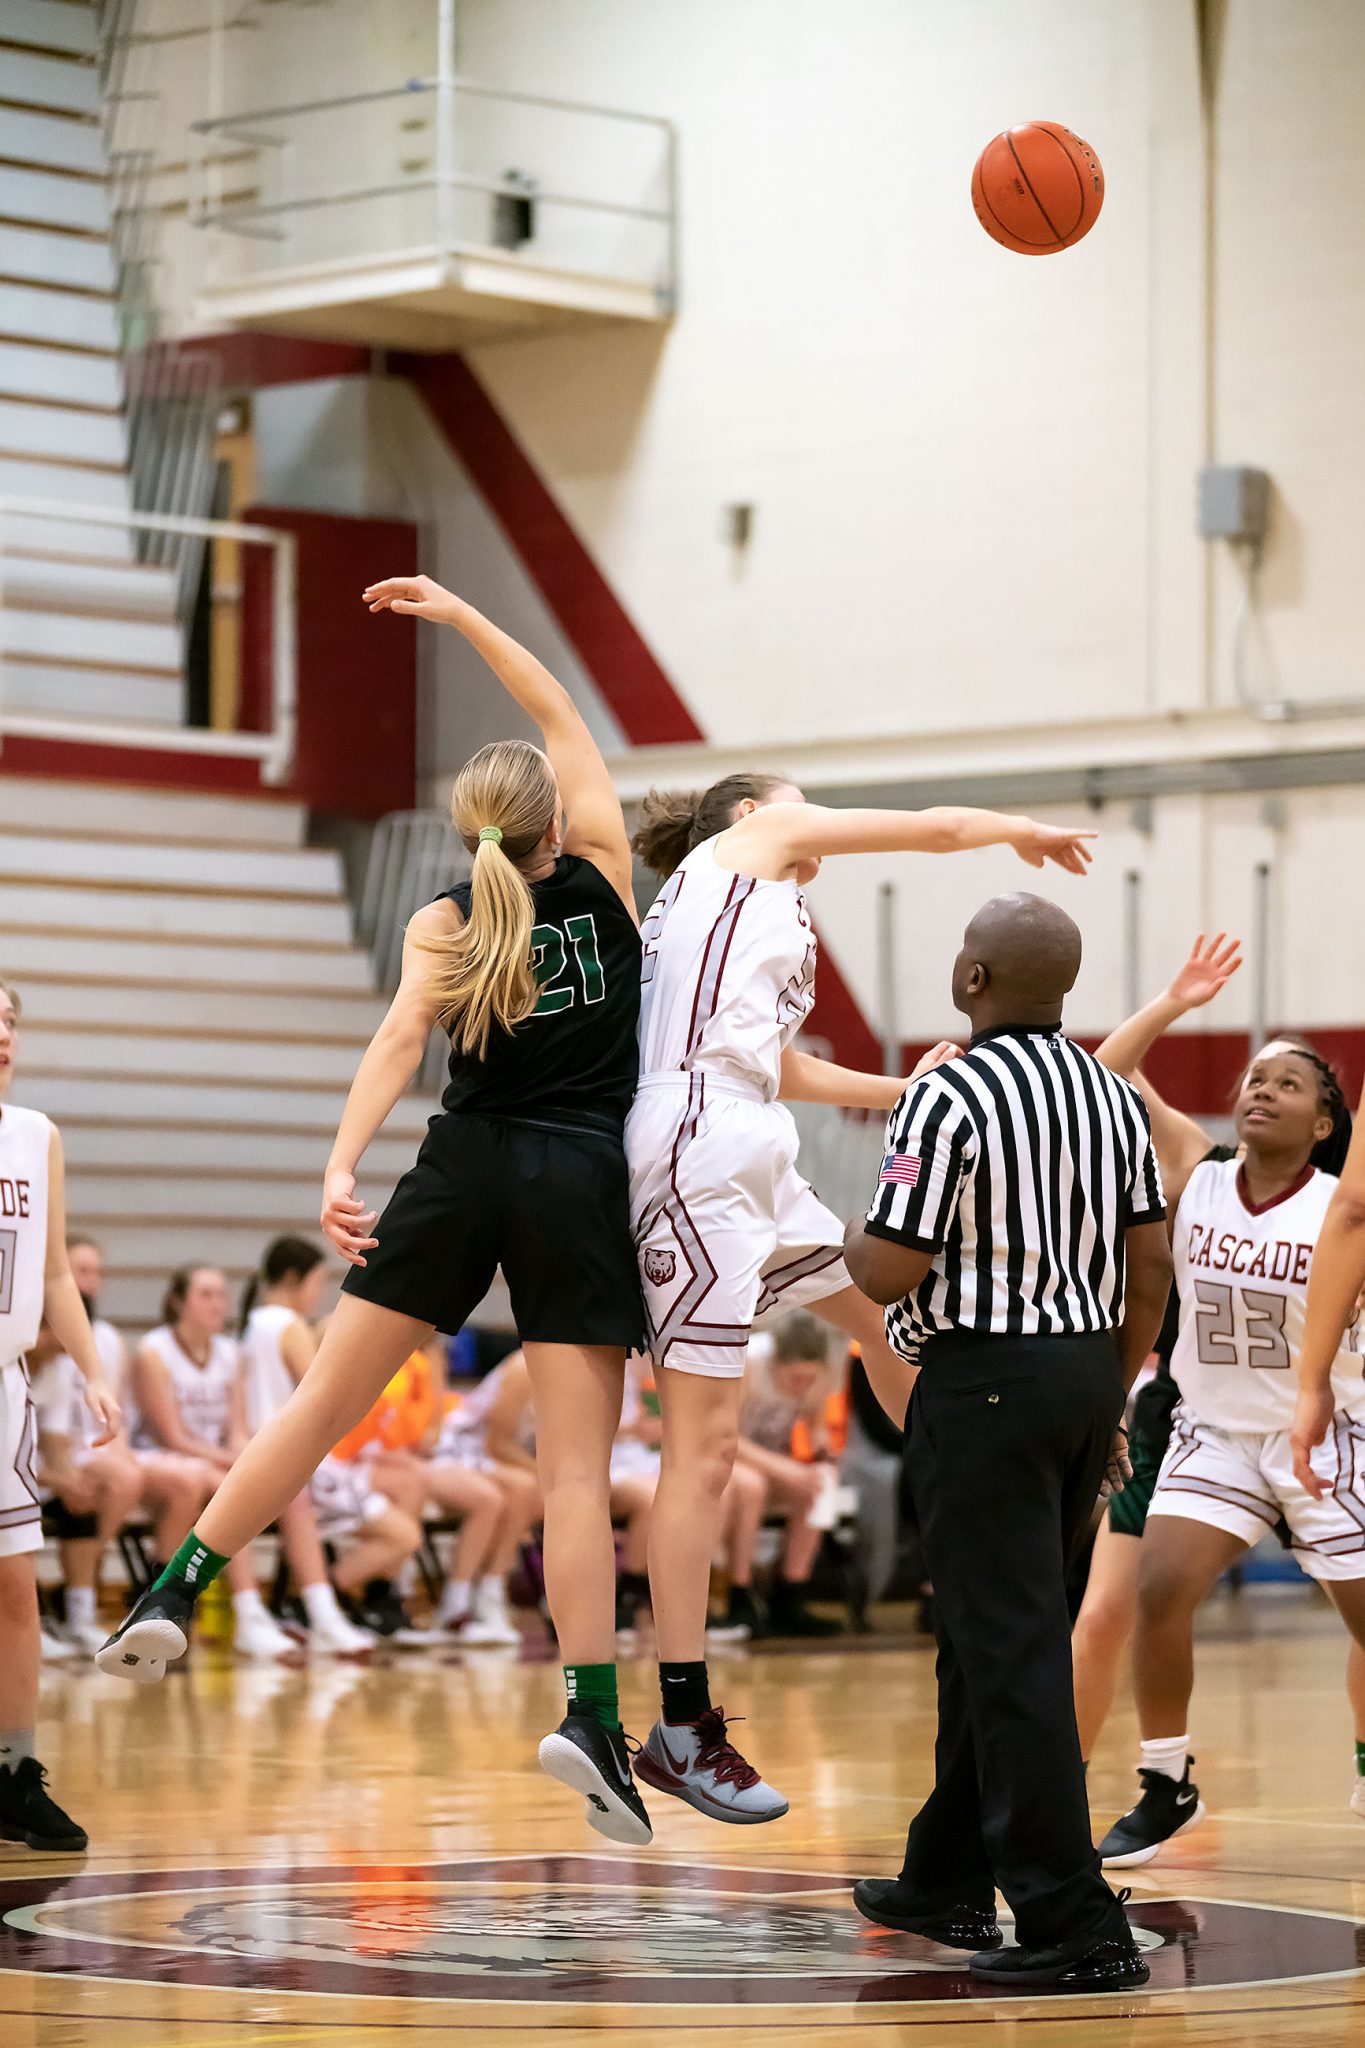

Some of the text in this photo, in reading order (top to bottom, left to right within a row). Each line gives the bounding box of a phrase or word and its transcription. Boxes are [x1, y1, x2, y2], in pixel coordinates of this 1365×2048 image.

[527, 913, 605, 1017] 21
[1188, 1223, 1313, 1285] CASCADE
[1193, 1278, 1291, 1370] 23
